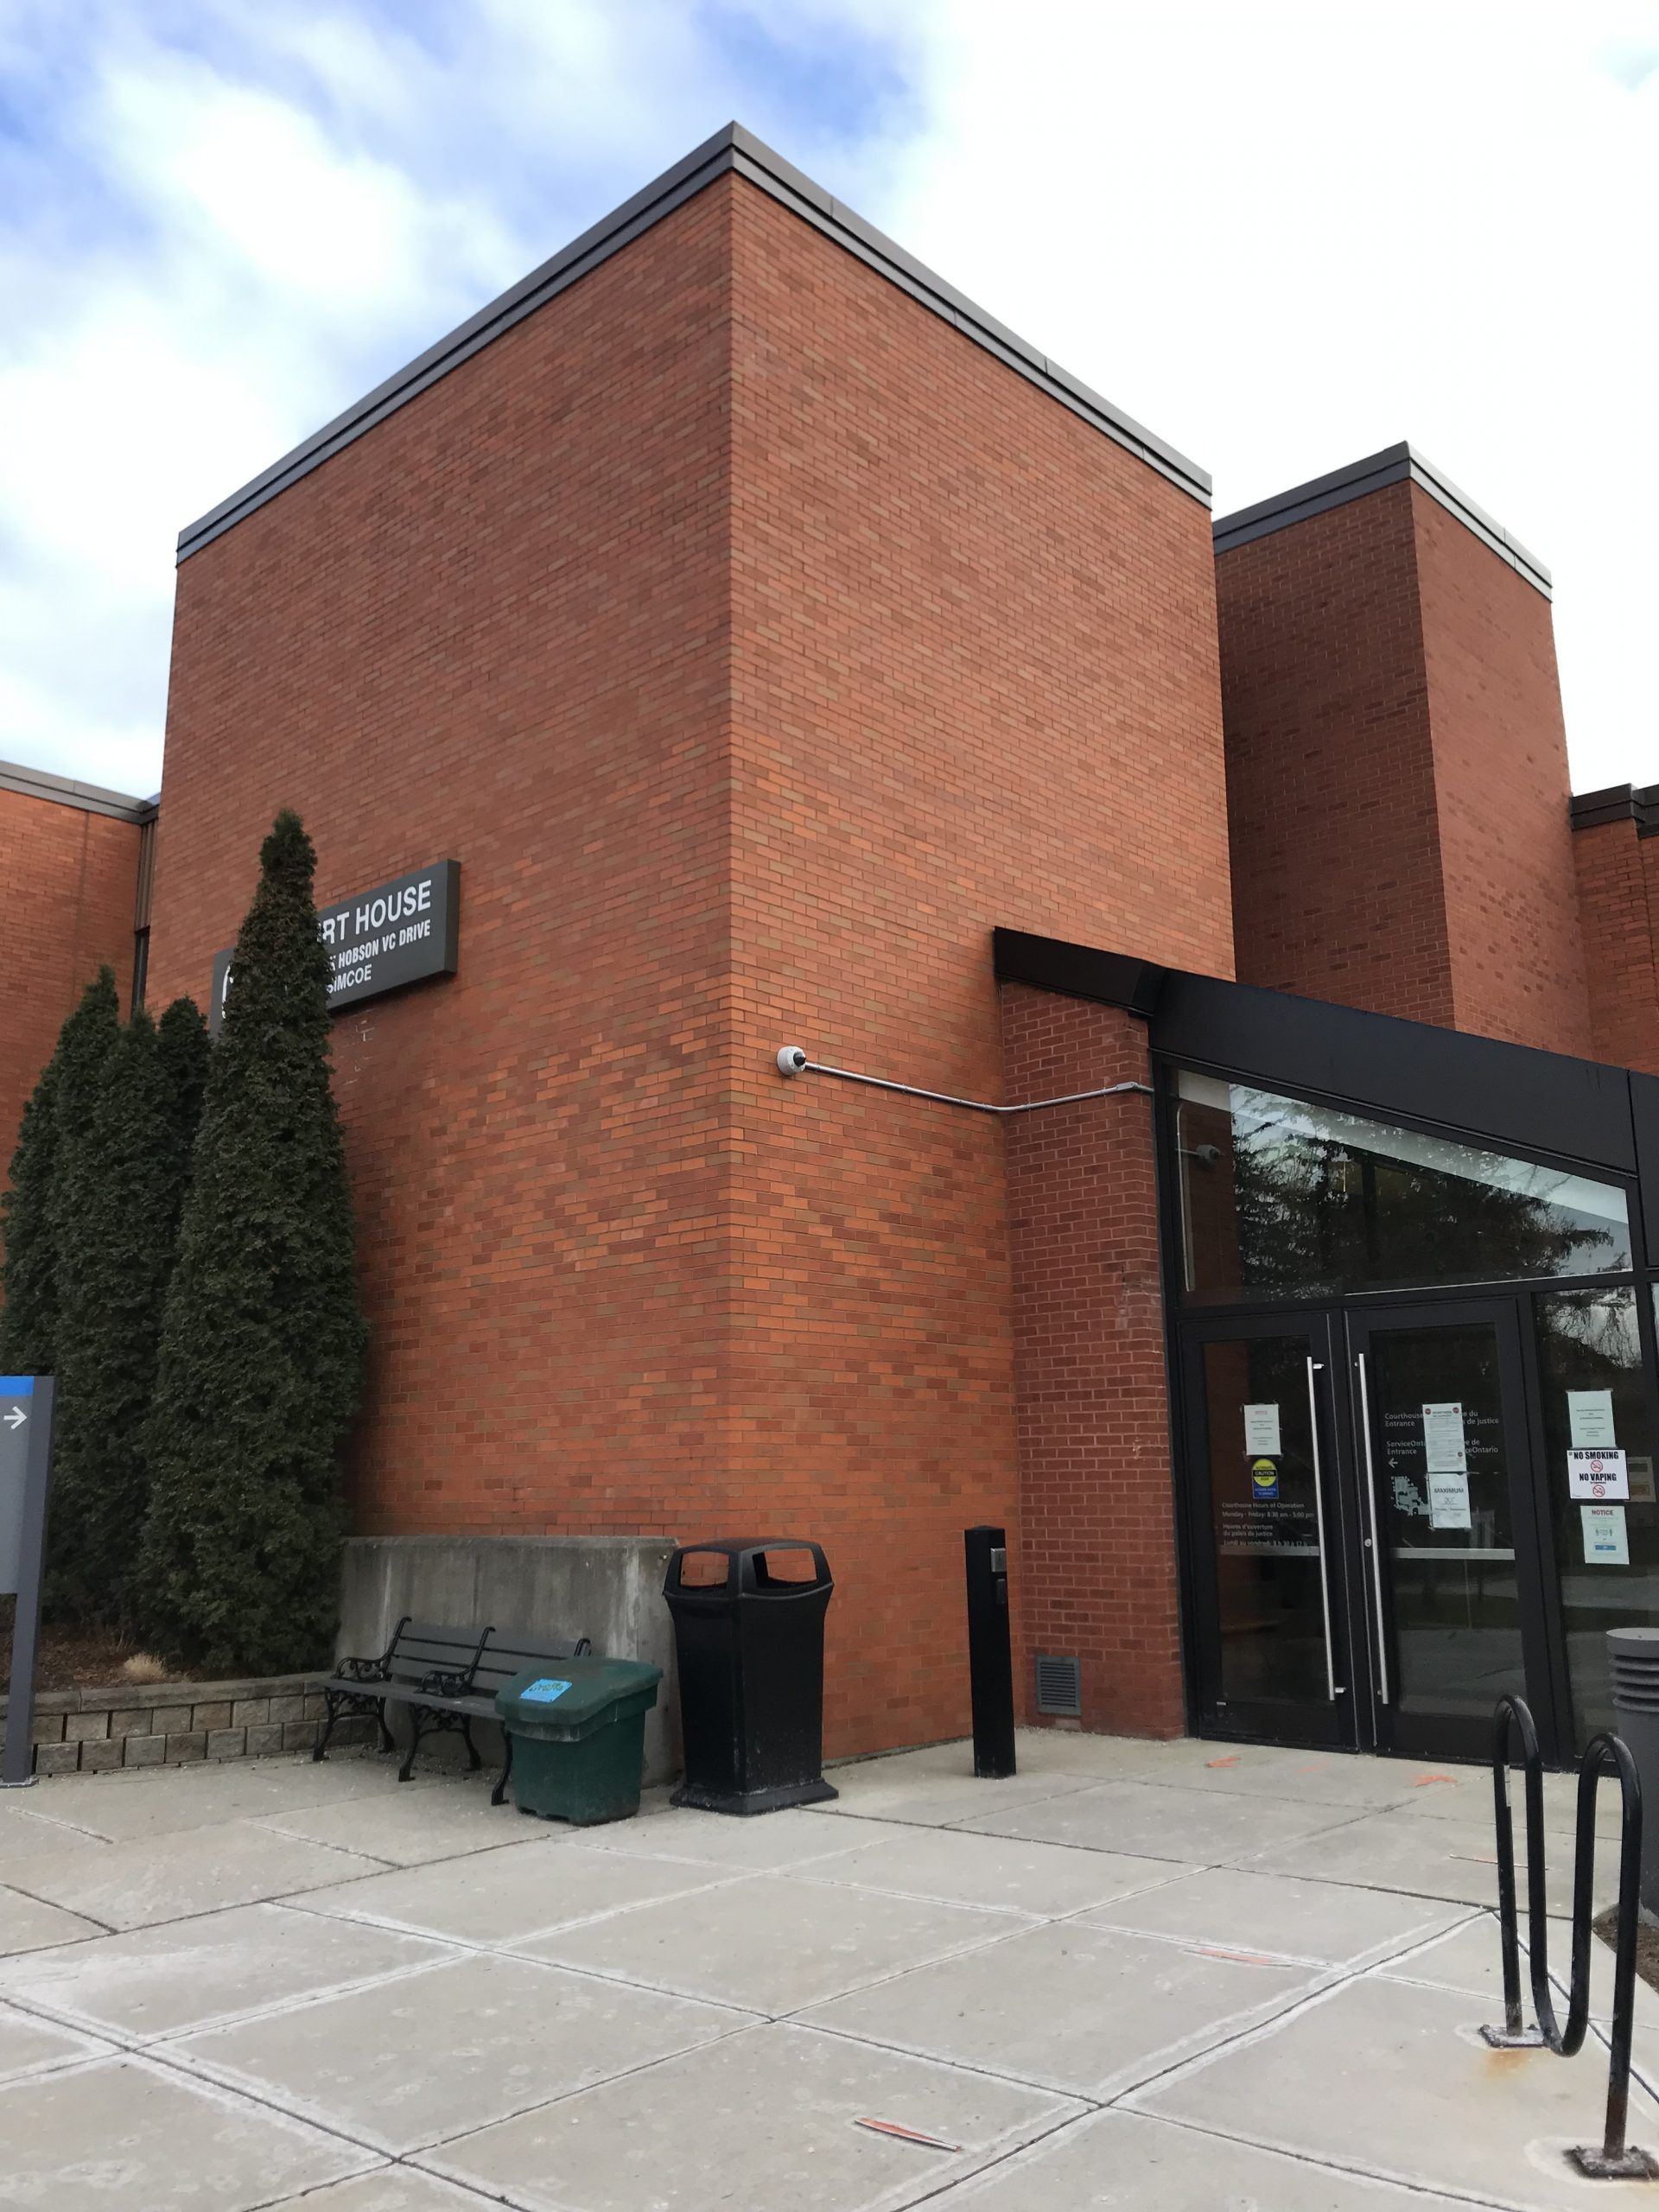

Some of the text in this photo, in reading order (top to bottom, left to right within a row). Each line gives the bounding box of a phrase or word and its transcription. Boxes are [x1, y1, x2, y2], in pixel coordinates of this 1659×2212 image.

[317, 880, 432, 944] RT HOUSE
[338, 939, 379, 969] HOBSON
[382, 932, 397, 952] VC
[399, 919, 431, 946] DRIVE
[1477, 1417, 1500, 1427] justice
[1465, 1445, 1499, 1453] ceOntario
[1573, 1451, 1619, 1460] NO SMOKING
[1579, 1472, 1618, 1482] NO VAPING
